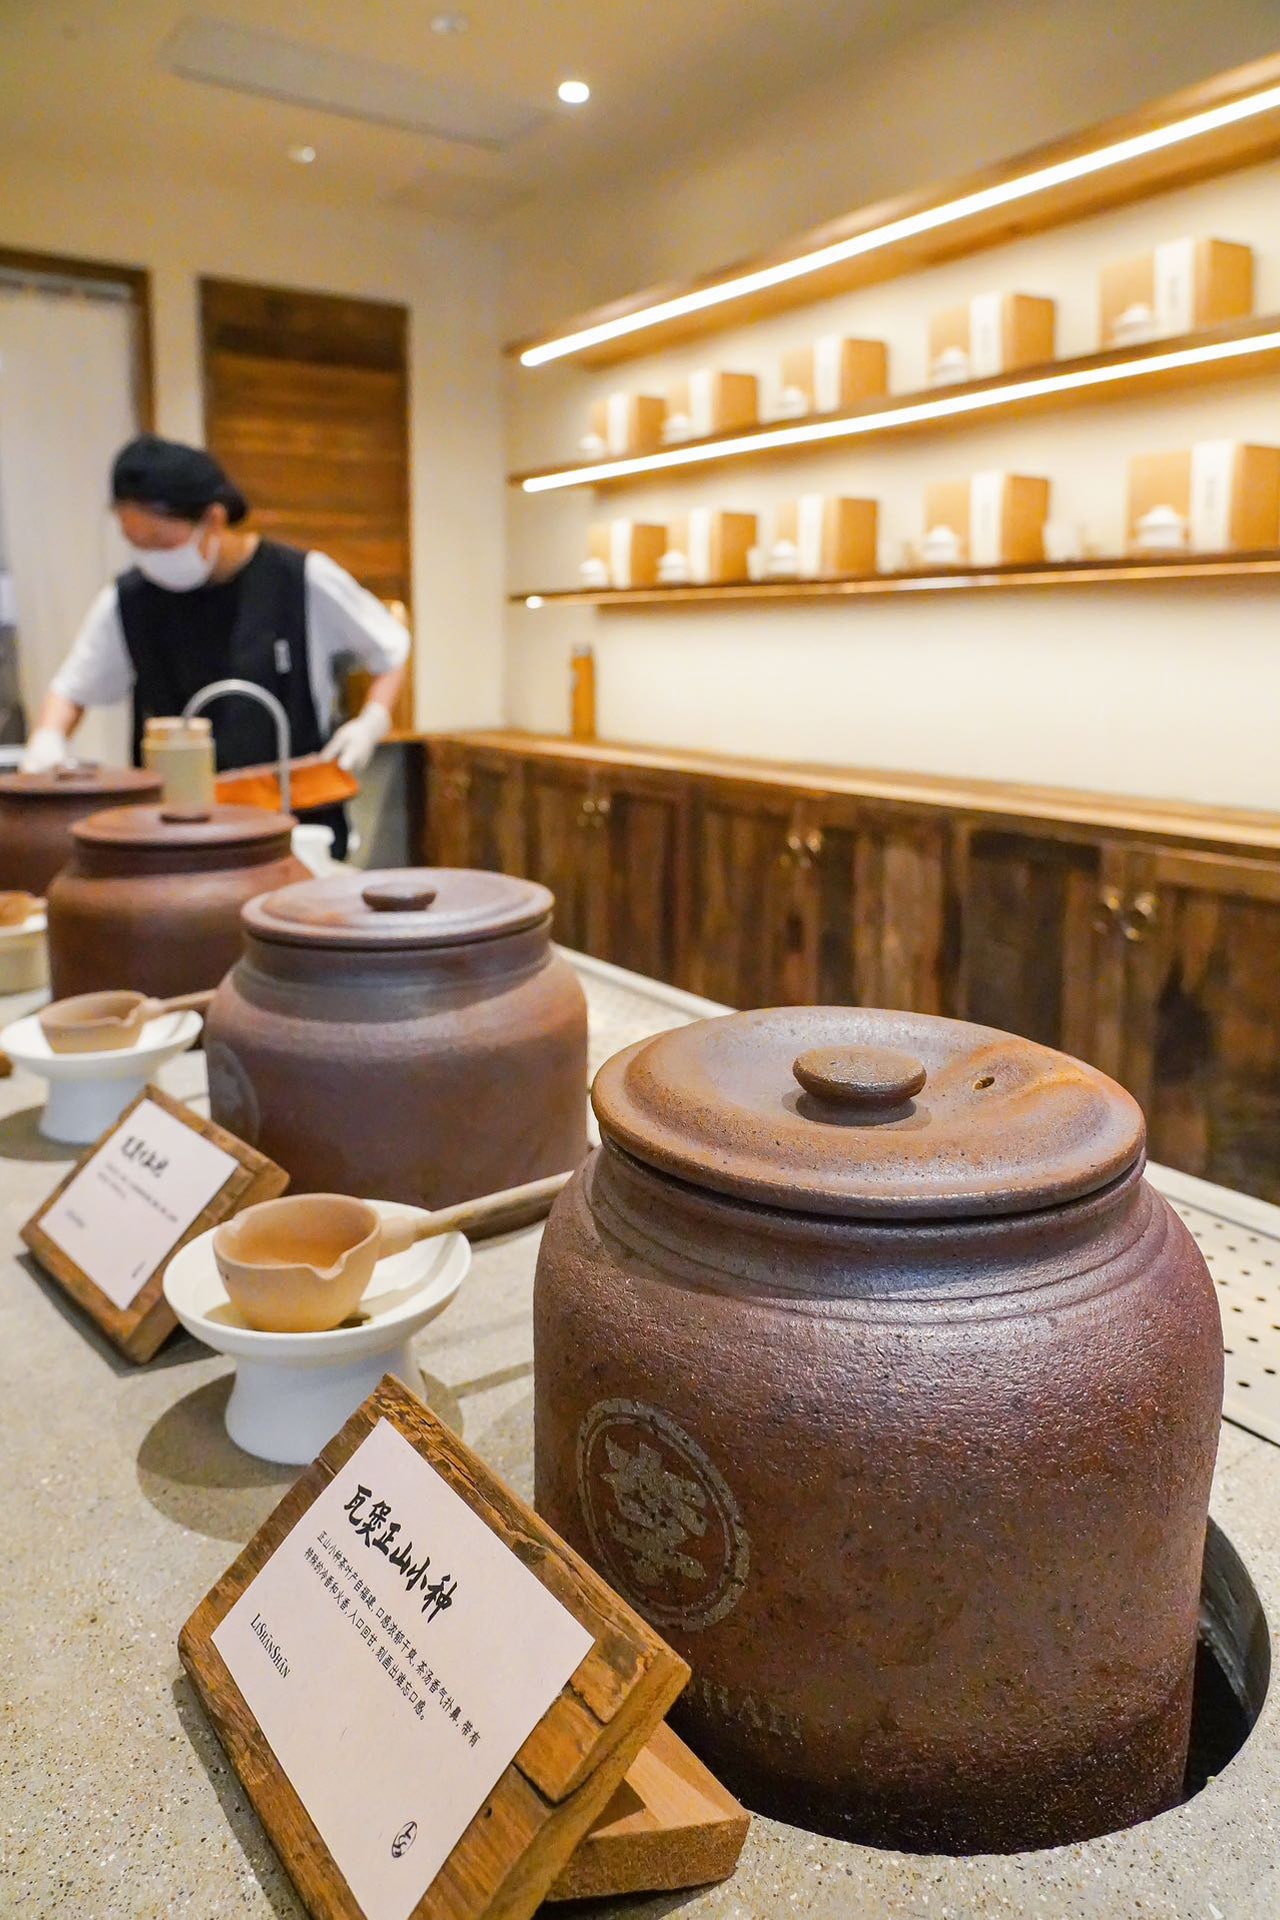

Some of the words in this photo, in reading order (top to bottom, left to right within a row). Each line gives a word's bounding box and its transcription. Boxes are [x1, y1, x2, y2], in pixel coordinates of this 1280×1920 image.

[344, 1484, 457, 1623] 瓦煲正山小种
